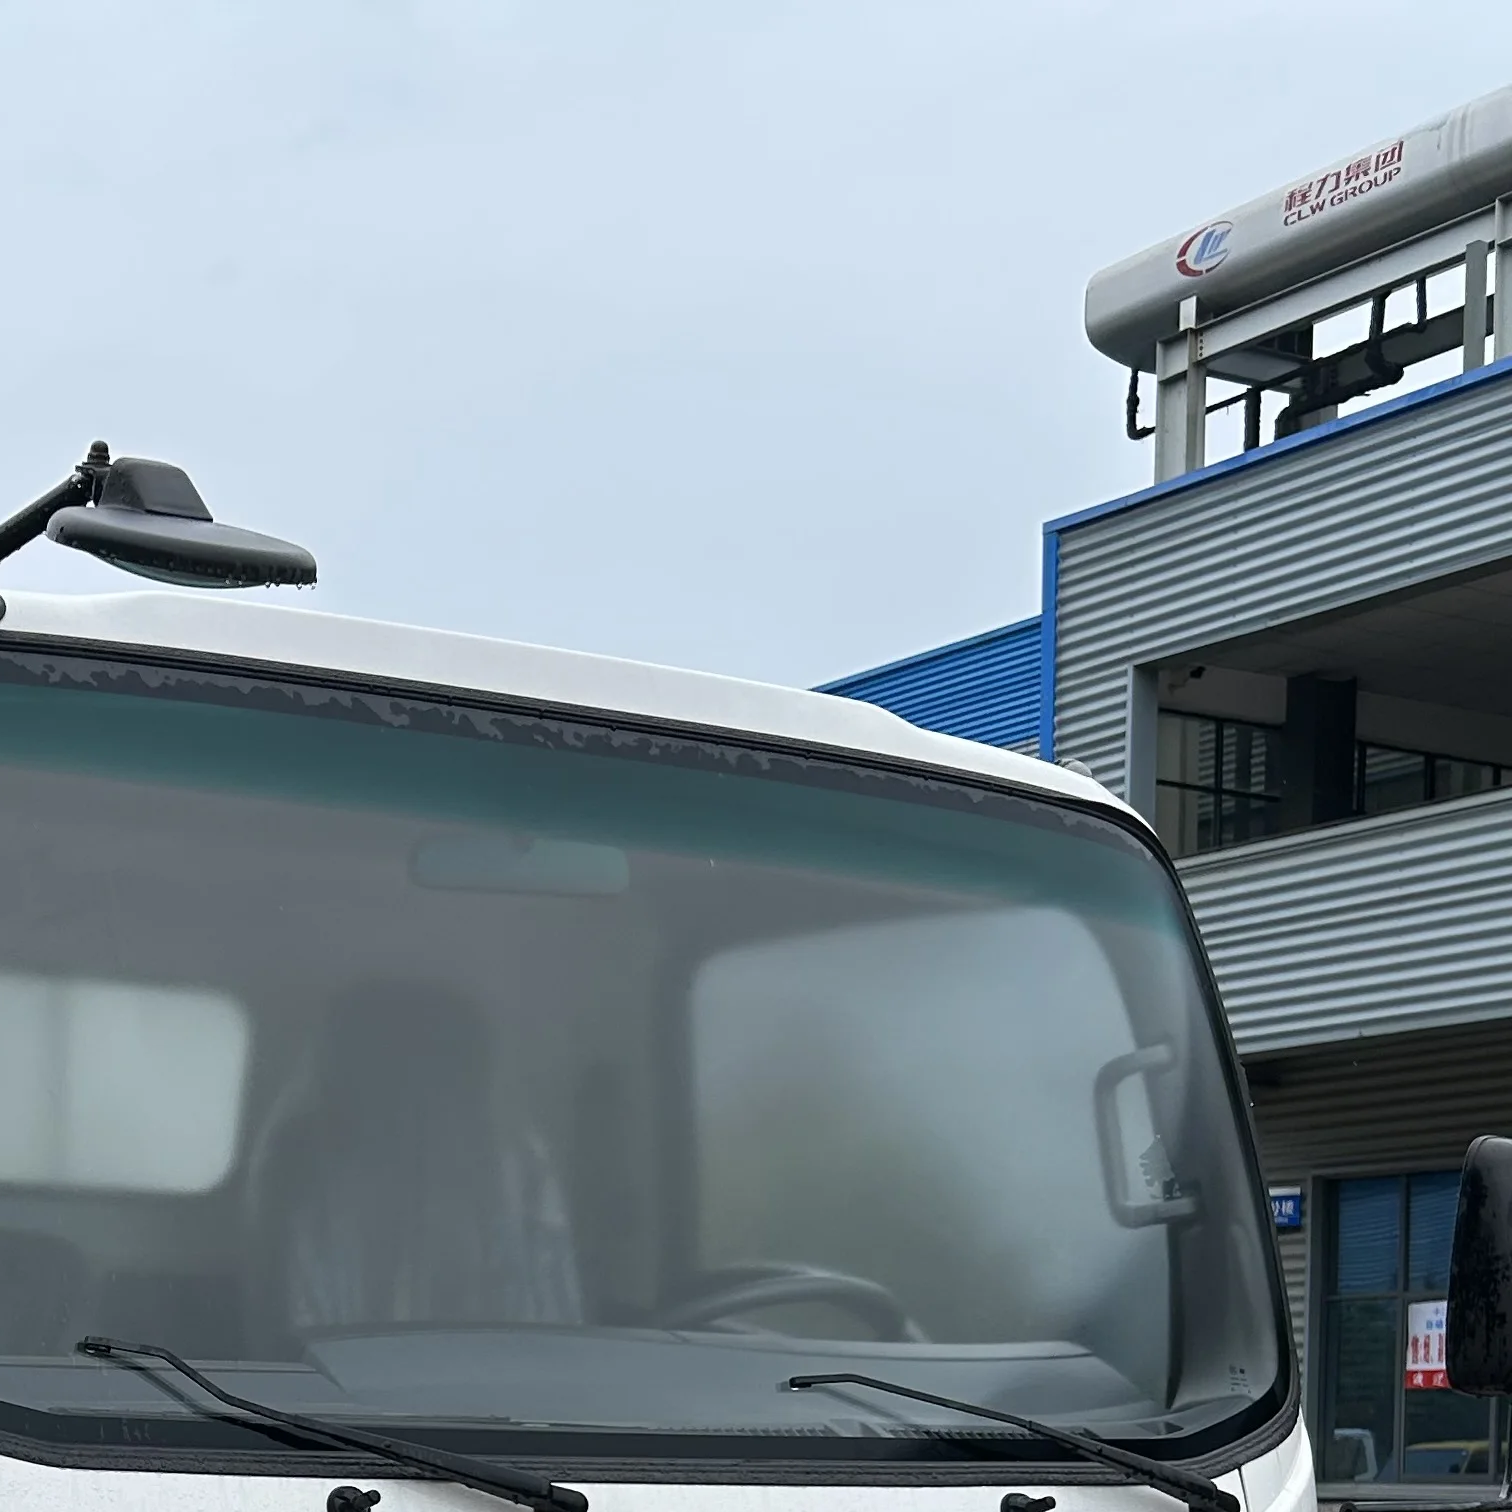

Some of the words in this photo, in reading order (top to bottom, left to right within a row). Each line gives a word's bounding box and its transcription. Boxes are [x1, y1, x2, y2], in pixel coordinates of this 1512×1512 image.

[1283, 139, 1404, 213] 程力集团
[1283, 199, 1326, 226] CLW
[1330, 167, 1401, 206] GROUP
